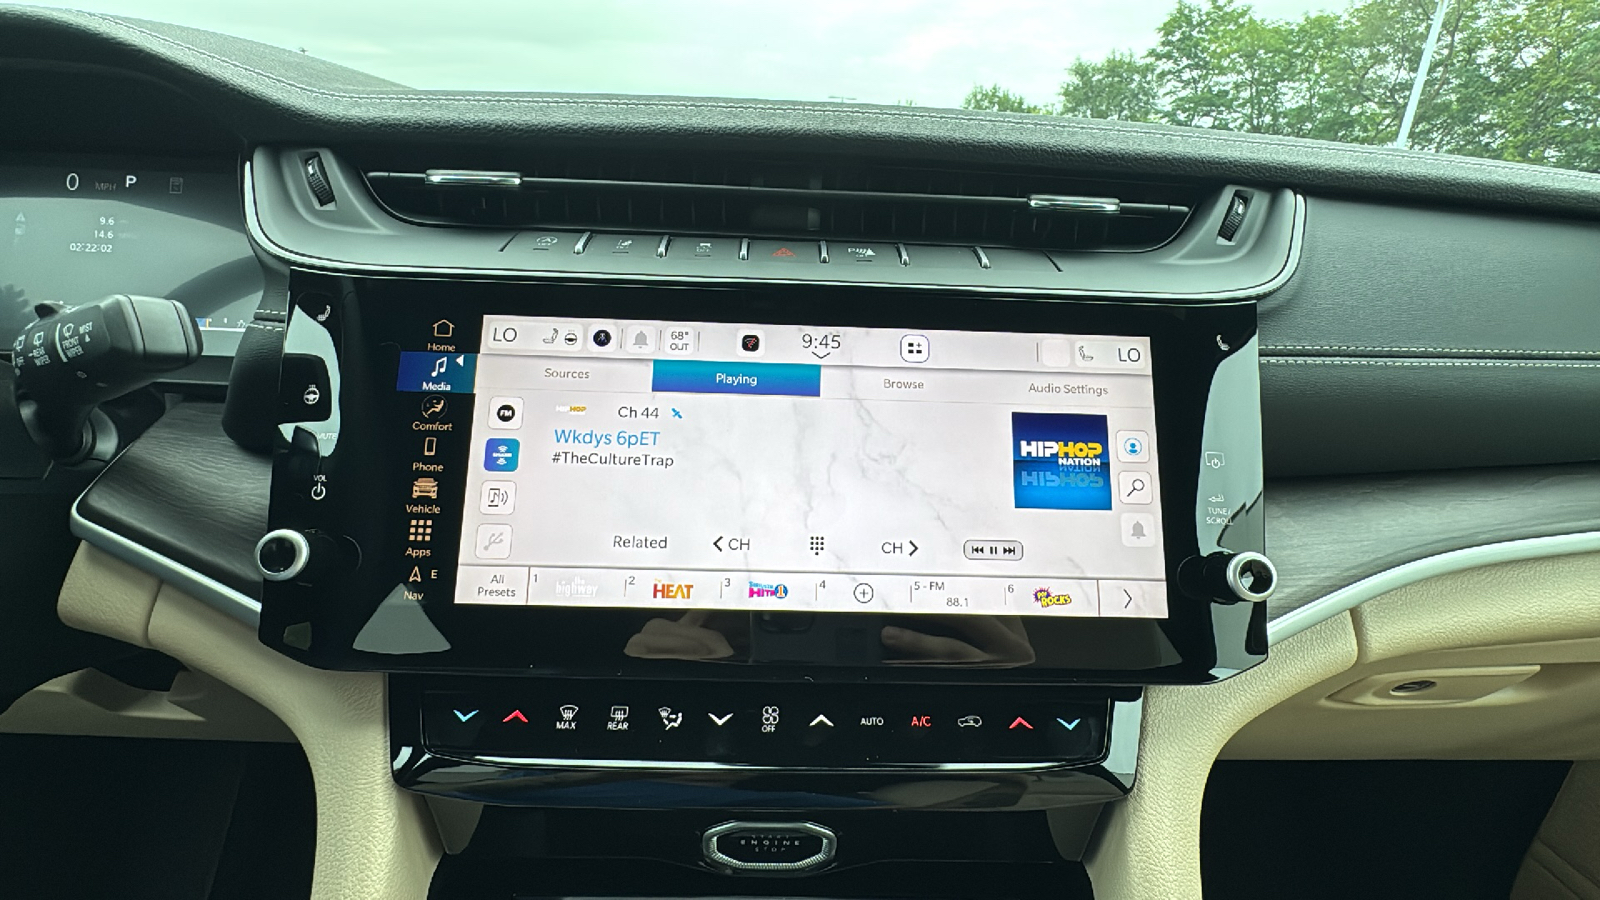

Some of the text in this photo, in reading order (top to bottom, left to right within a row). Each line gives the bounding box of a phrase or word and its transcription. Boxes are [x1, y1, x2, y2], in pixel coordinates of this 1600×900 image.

[95, 182, 117, 191] MPH
[125, 175, 137, 188] P
[99, 217, 115, 226] 9.6
[94, 230, 114, 239] 14.6
[69, 242, 113, 253] 02:22:02
[492, 327, 518, 343] LO
[669, 342, 690, 351] OUT
[801, 333, 841, 350] 9:45
[427, 342, 456, 352] Home
[1117, 347, 1141, 363] LO
[544, 367, 590, 379] Sources
[715, 372, 758, 387] Playing
[883, 378, 925, 390] Browse
[422, 381, 451, 391] Media
[1028, 382, 1109, 397] Audio Settings
[499, 409, 513, 417] FM
[617, 406, 660, 419] Ch 44
[412, 420, 453, 431] Comfort
[554, 428, 661, 448] Wkdys 6pET
[551, 451, 675, 469] #TheCultureTrap
[1058, 457, 1101, 466] NATION
[412, 461, 444, 472] Phone
[405, 504, 441, 514] Vehicle
[613, 535, 668, 549] Related
[728, 538, 751, 551] CH
[404, 547, 431, 558] Apps
[881, 542, 904, 554] CH
[431, 569, 438, 579] E
[490, 574, 505, 584] All
[533, 574, 538, 583] 1
[628, 576, 636, 585] 2
[724, 578, 731, 587] 3
[818, 580, 826, 589] 4
[653, 583, 694, 599] HEAT
[929, 582, 945, 591] FM
[1007, 584, 1014, 593] 6
[403, 591, 424, 600] Nav
[477, 586, 516, 598] Presets
[946, 597, 969, 607] 88.1
[1041, 594, 1072, 608] ROCKS
[556, 721, 577, 730] MAX
[607, 721, 629, 730] REAR
[860, 717, 884, 726] AUTO
[911, 716, 931, 727] A/C
[761, 724, 776, 733] OFF
